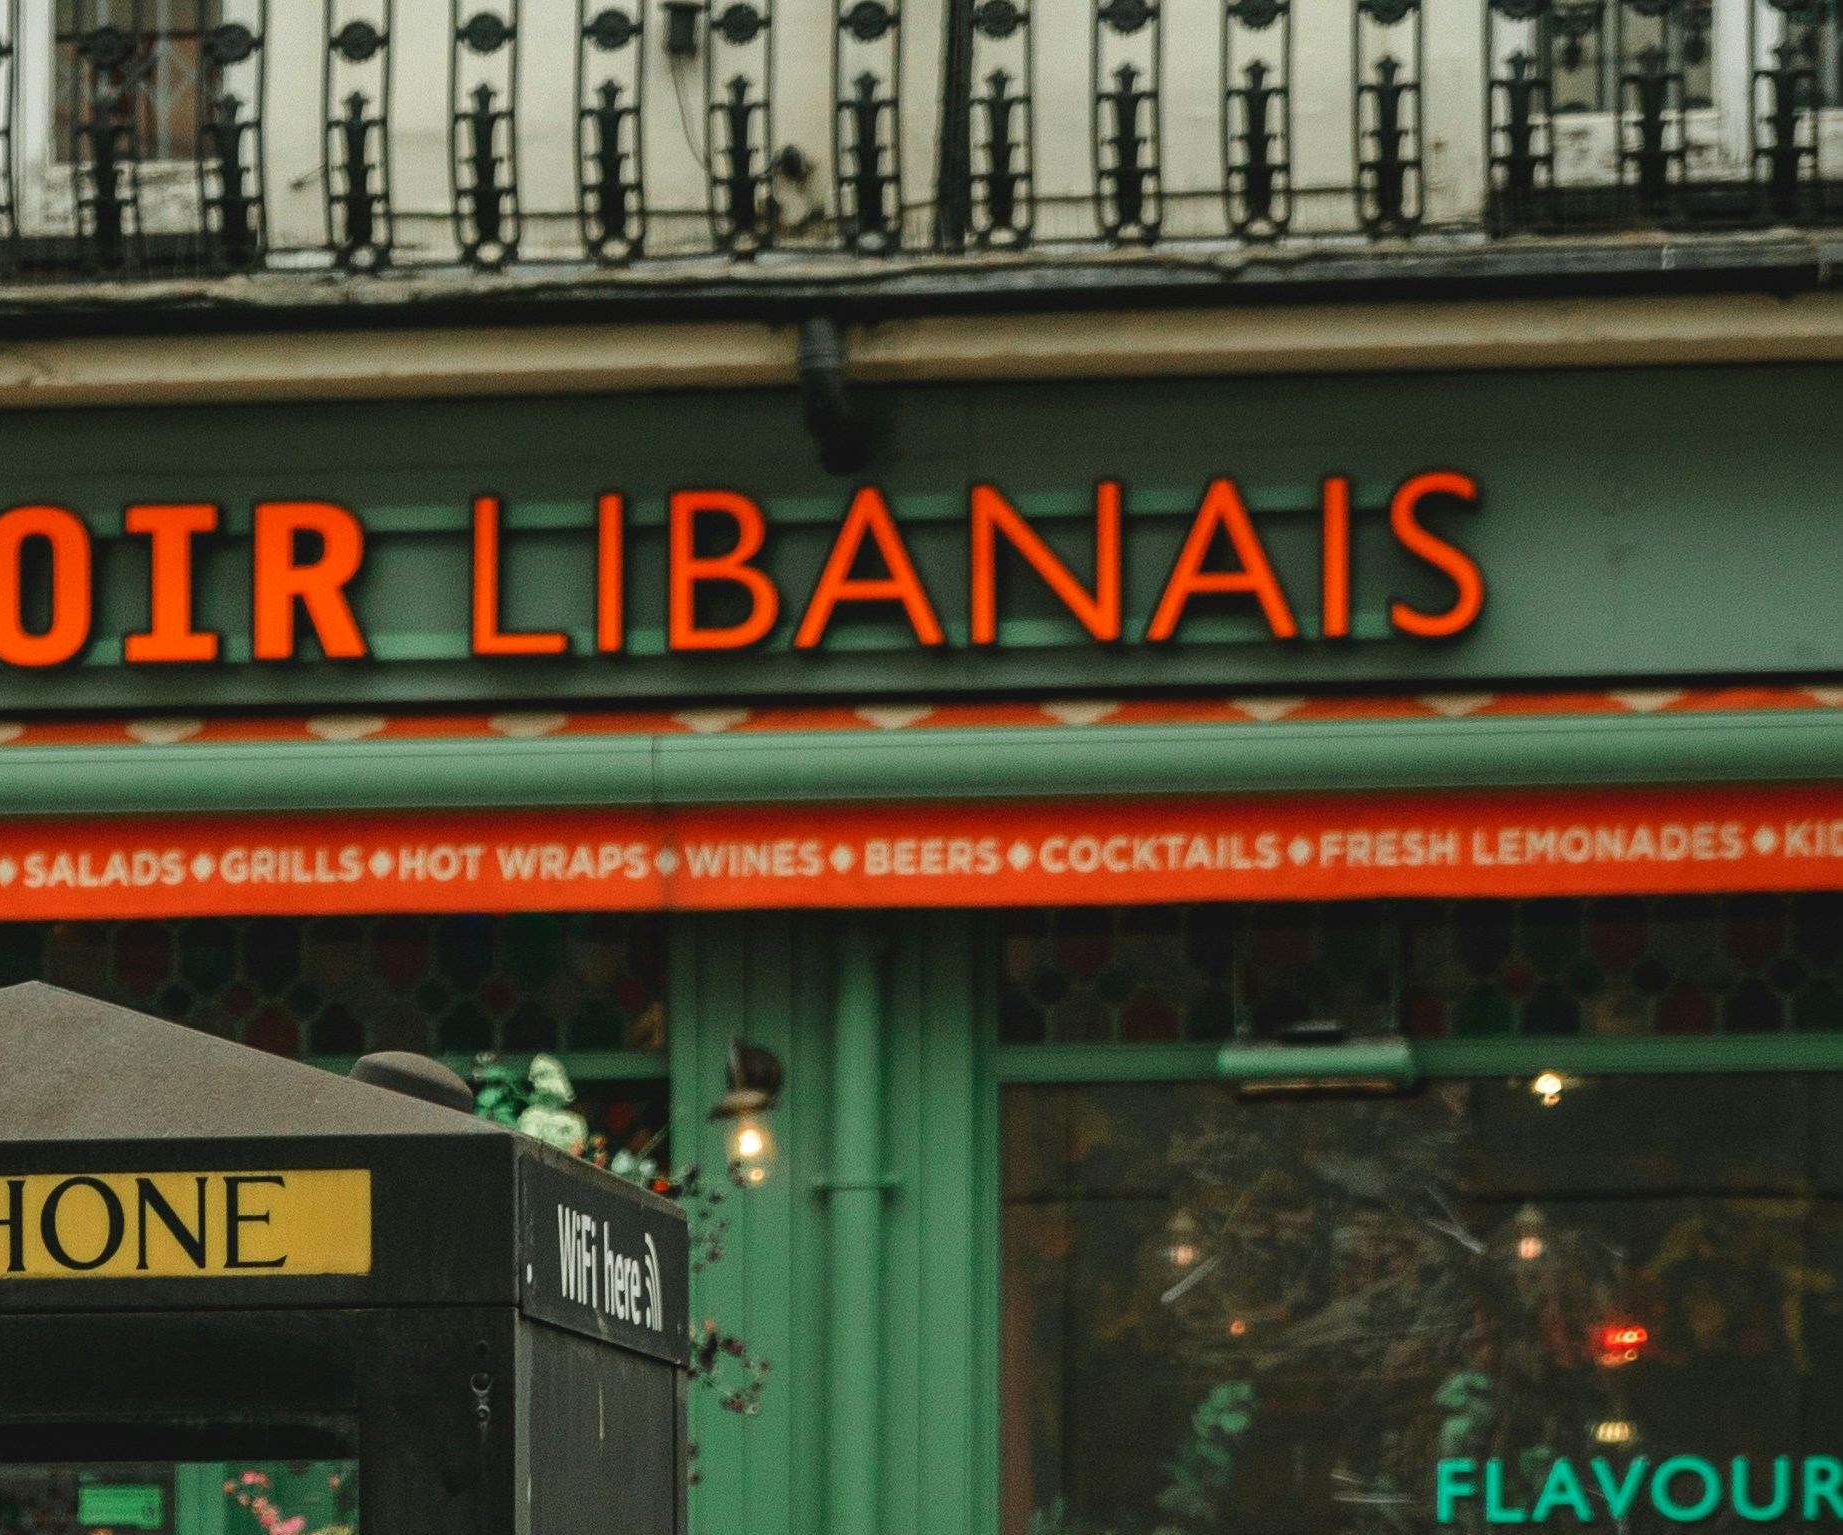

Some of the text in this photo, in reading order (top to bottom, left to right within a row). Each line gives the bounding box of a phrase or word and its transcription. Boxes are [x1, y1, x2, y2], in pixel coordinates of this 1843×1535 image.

[471, 471, 1485, 656] LIBANAIS
[22, 848, 188, 891] SALADS
[217, 845, 362, 887] GRILLS
[396, 843, 487, 883] HOT
[495, 842, 648, 882] WRAPS
[683, 839, 826, 880] WINES
[862, 837, 1004, 878] BEERS
[1037, 832, 1283, 876] COCKTAILS
[1318, 829, 1460, 869] FRESH
[1471, 823, 1746, 867] LEMONADES
[602, 1220, 642, 1326] here
